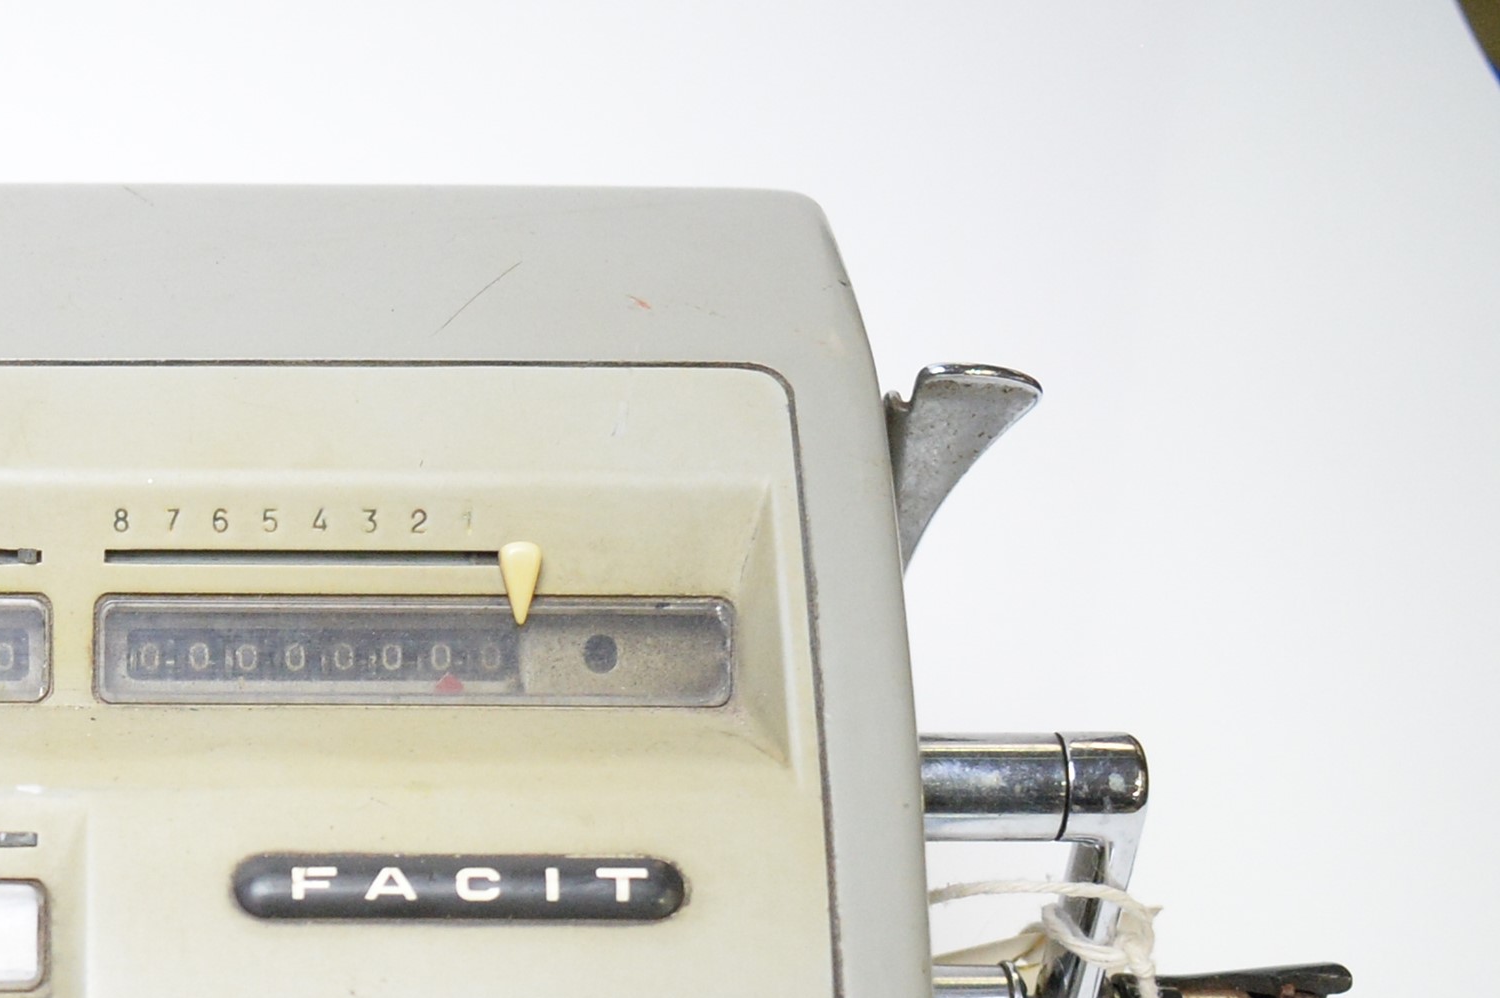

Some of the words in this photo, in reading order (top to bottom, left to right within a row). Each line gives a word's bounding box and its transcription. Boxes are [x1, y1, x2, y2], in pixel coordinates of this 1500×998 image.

[113, 508, 129, 533] 8
[167, 508, 180, 531] 7
[212, 508, 229, 533] 6
[262, 508, 278, 532] 5
[312, 508, 328, 531] 4
[362, 509, 377, 533] 3
[411, 508, 427, 533] 2
[290, 866, 649, 902] FACIT
